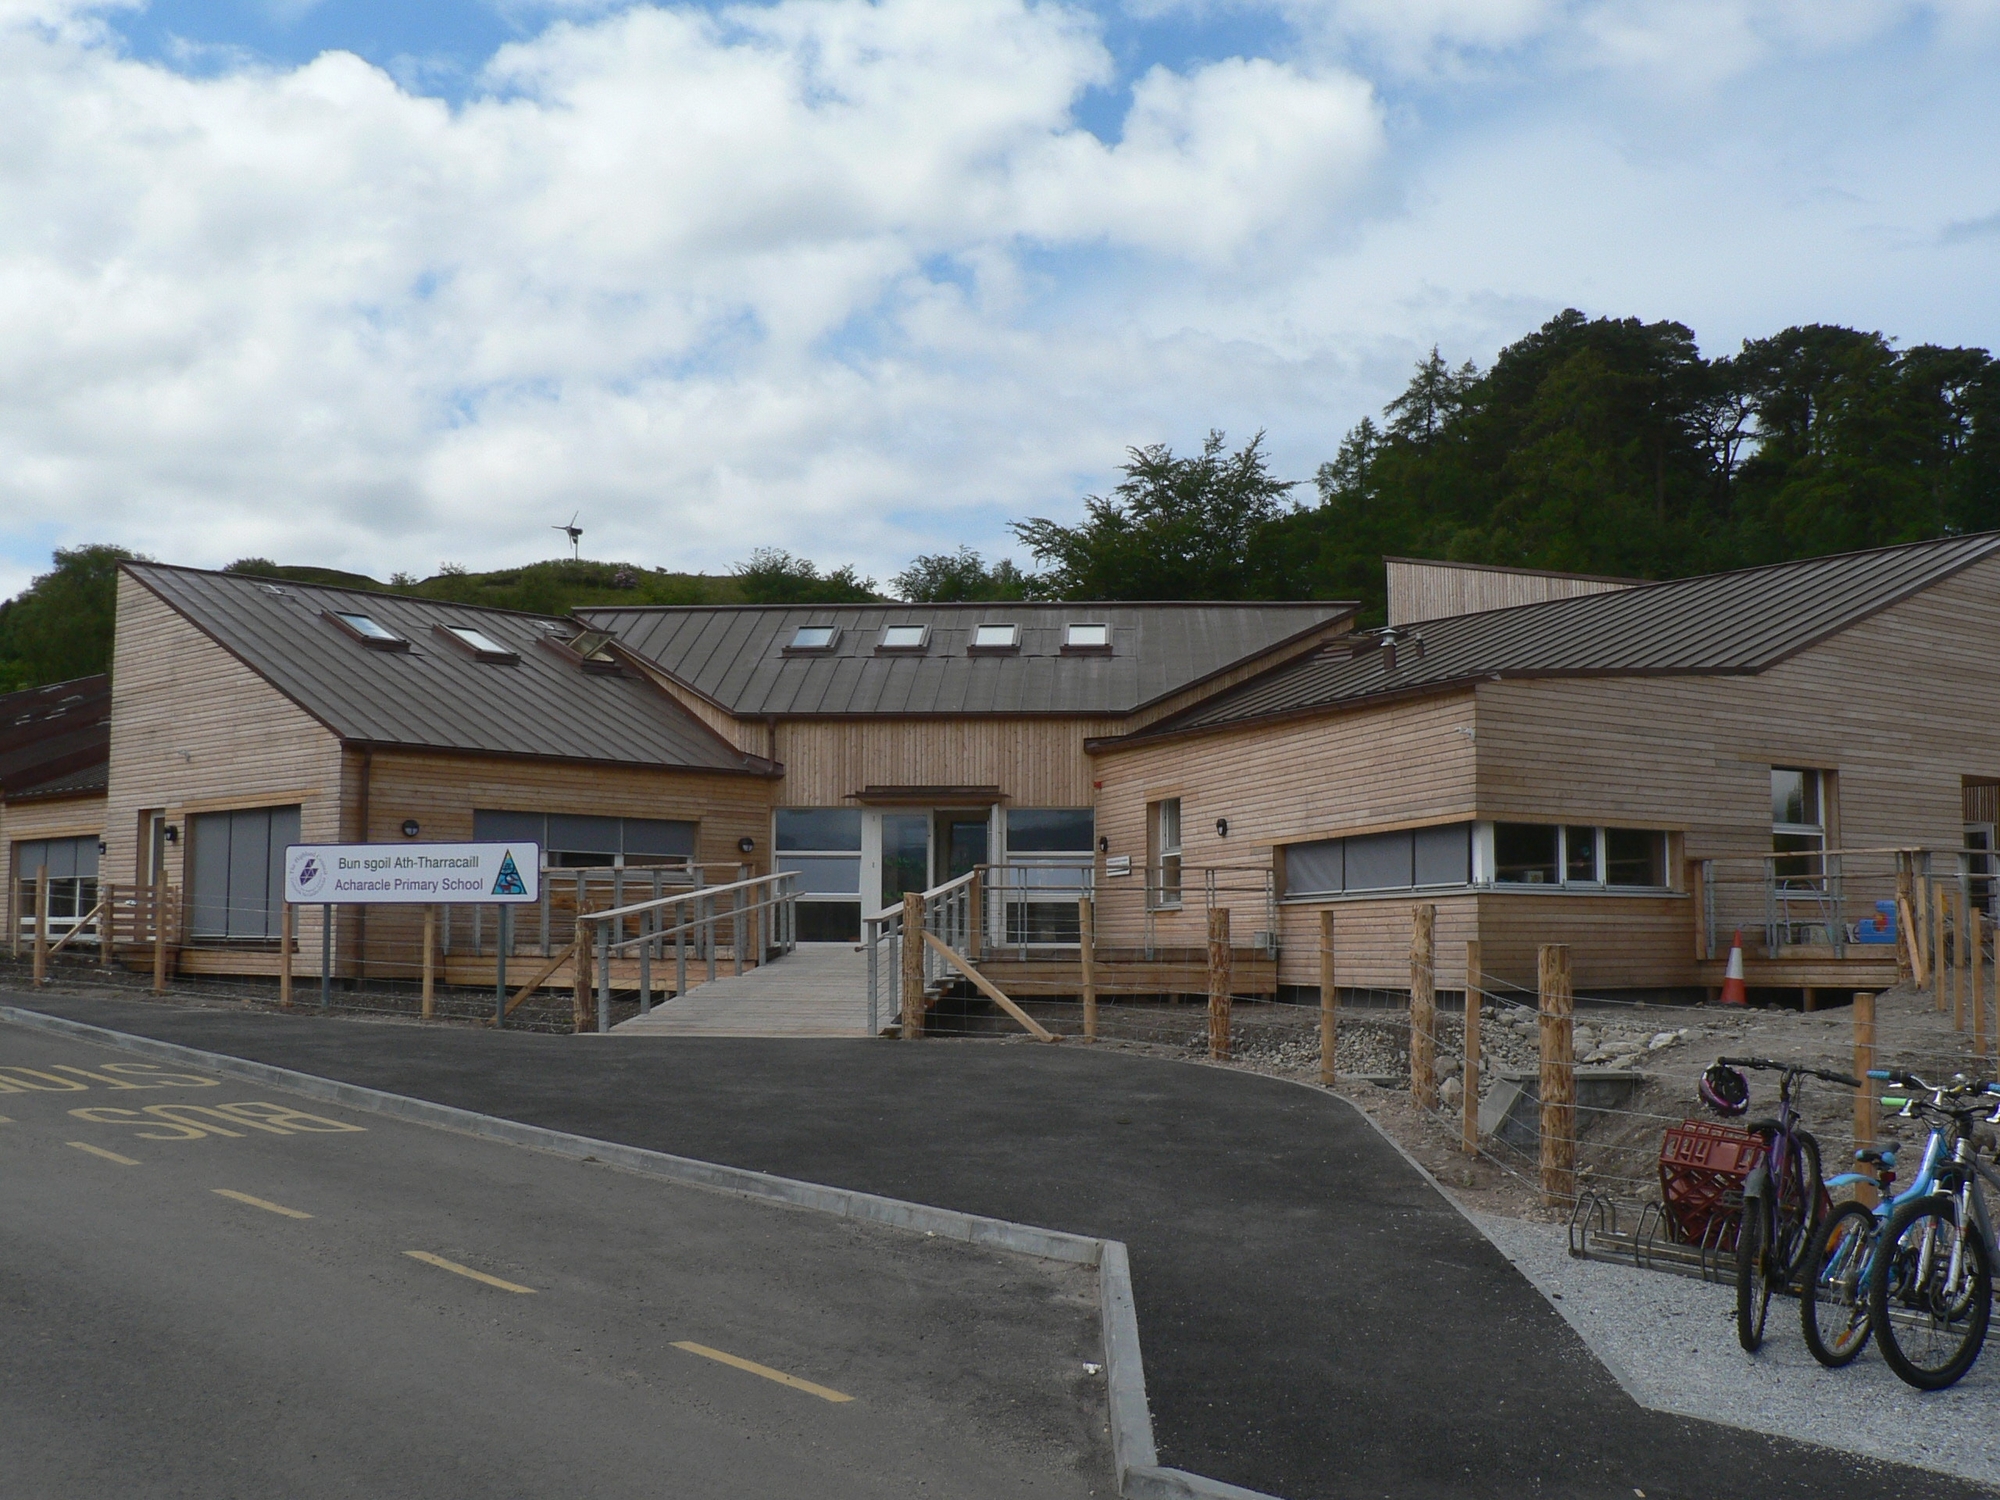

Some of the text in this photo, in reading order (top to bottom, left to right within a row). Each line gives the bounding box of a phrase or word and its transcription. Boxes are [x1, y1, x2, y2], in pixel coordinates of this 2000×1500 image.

[338, 855, 479, 872] Bun sgoil Ath-Tharracaill
[334, 878, 391, 891] Acharacle
[394, 878, 439, 894] Primary
[442, 877, 483, 891] School
[0, 1064, 221, 1094] STO
[67, 1101, 369, 1140] BUS
